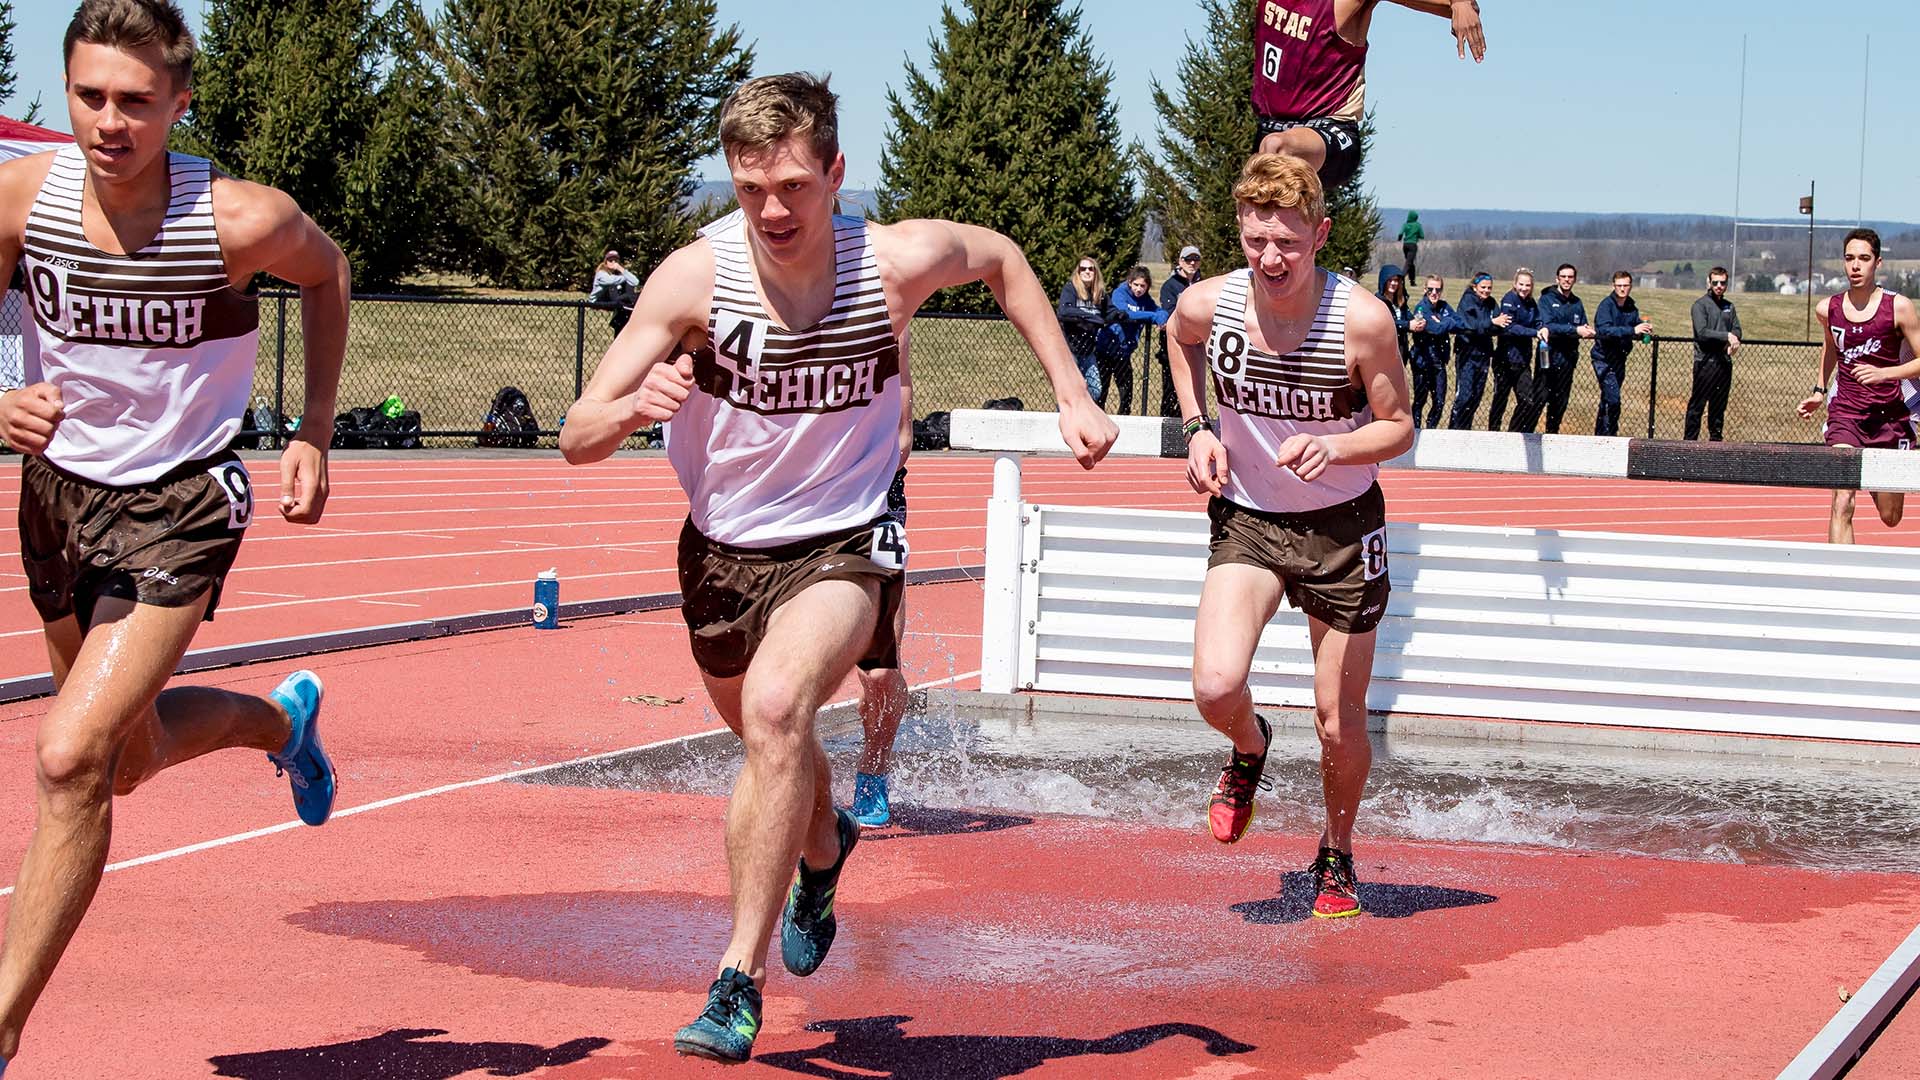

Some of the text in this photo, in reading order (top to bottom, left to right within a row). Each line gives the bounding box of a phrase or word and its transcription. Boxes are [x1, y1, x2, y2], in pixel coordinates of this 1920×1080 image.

[1263, 1, 1313, 41] STAC
[1265, 47, 1278, 77] 6
[54, 255, 80, 270] asics
[32, 265, 60, 322] 9
[66, 293, 206, 345] EHIGH
[1832, 328, 1843, 348] 7
[719, 319, 755, 375] 4
[1217, 331, 1245, 375] 8
[223, 465, 252, 523] 9
[877, 523, 906, 564] 4
[1368, 533, 1384, 575] 8
